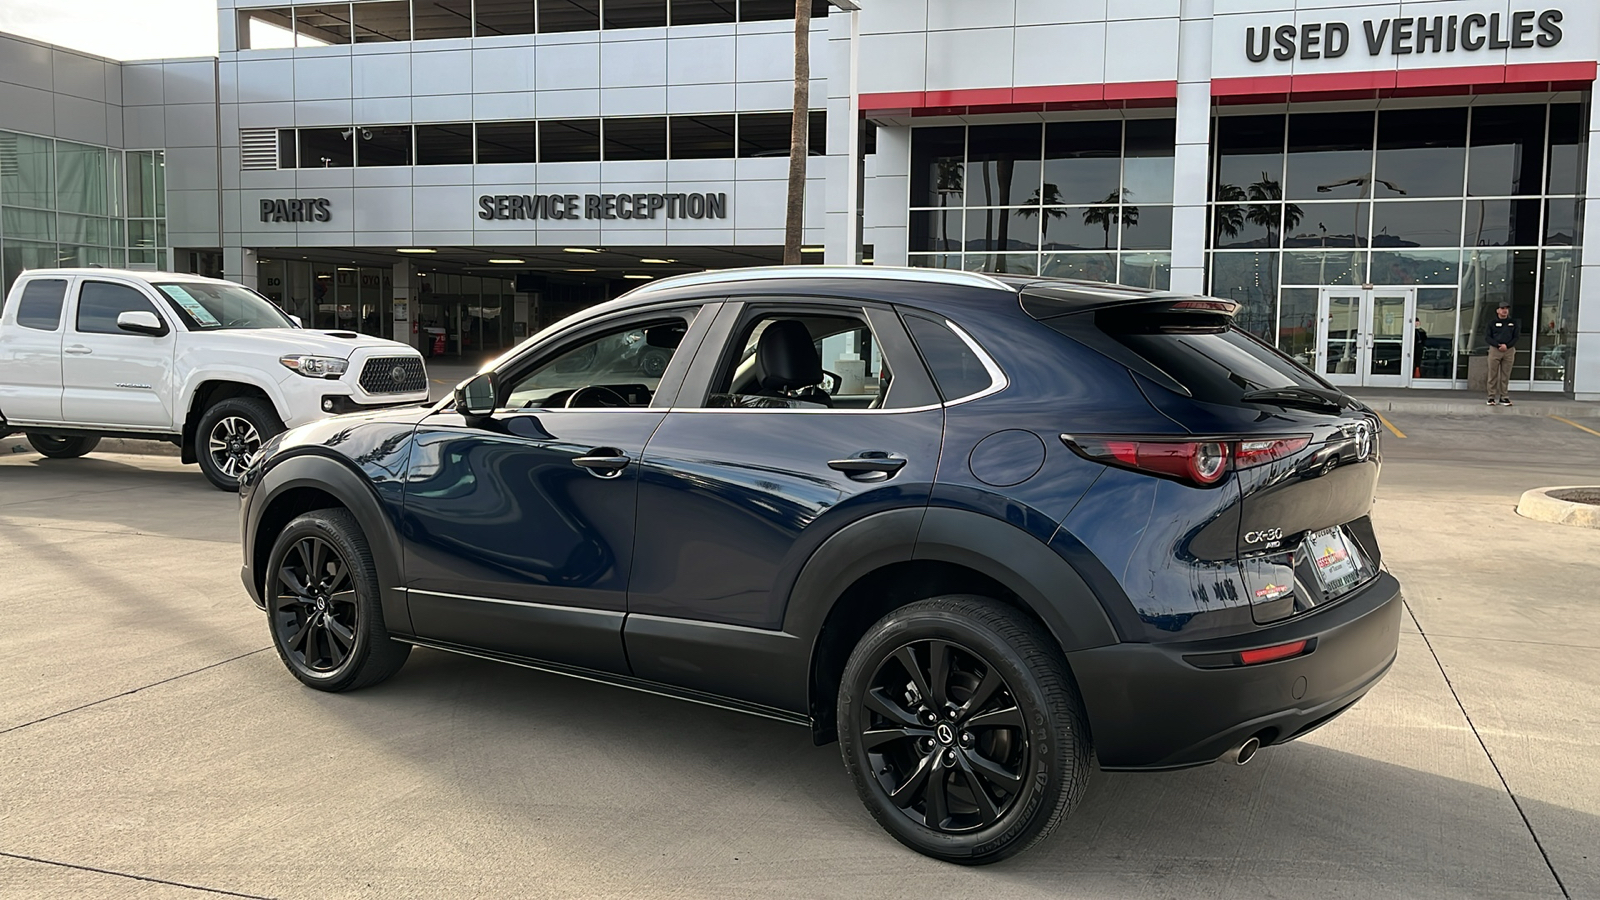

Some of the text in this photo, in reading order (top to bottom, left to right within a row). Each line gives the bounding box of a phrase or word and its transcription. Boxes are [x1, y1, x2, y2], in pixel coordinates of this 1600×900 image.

[1245, 10, 1563, 63] USED VEHICLES
[260, 197, 332, 224] PARTS
[478, 192, 726, 221] SERVICE RECEPTION
[1244, 527, 1283, 544] CX-30
